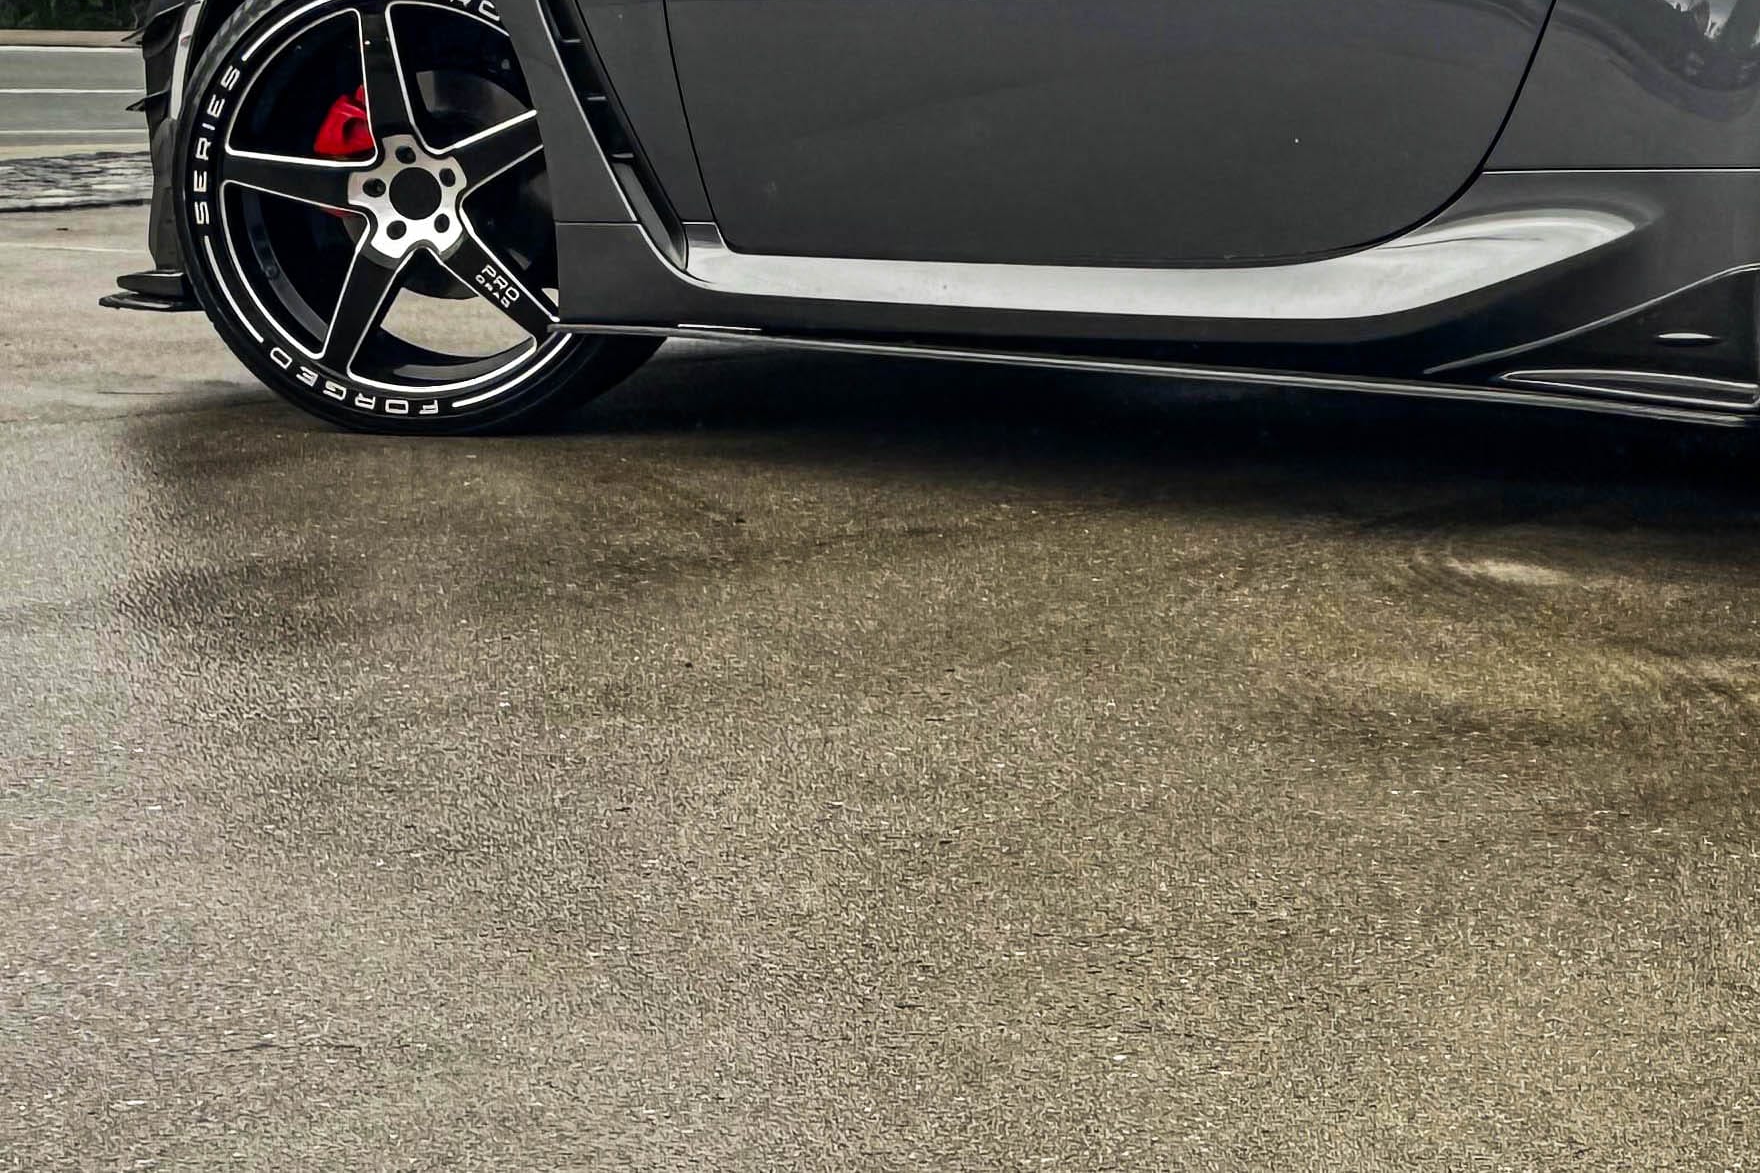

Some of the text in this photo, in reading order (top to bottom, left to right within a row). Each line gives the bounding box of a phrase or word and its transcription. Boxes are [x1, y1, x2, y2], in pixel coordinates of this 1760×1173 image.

[194, 64, 242, 225] SERIES
[481, 264, 520, 302] PRO
[270, 346, 440, 415] FORGED
